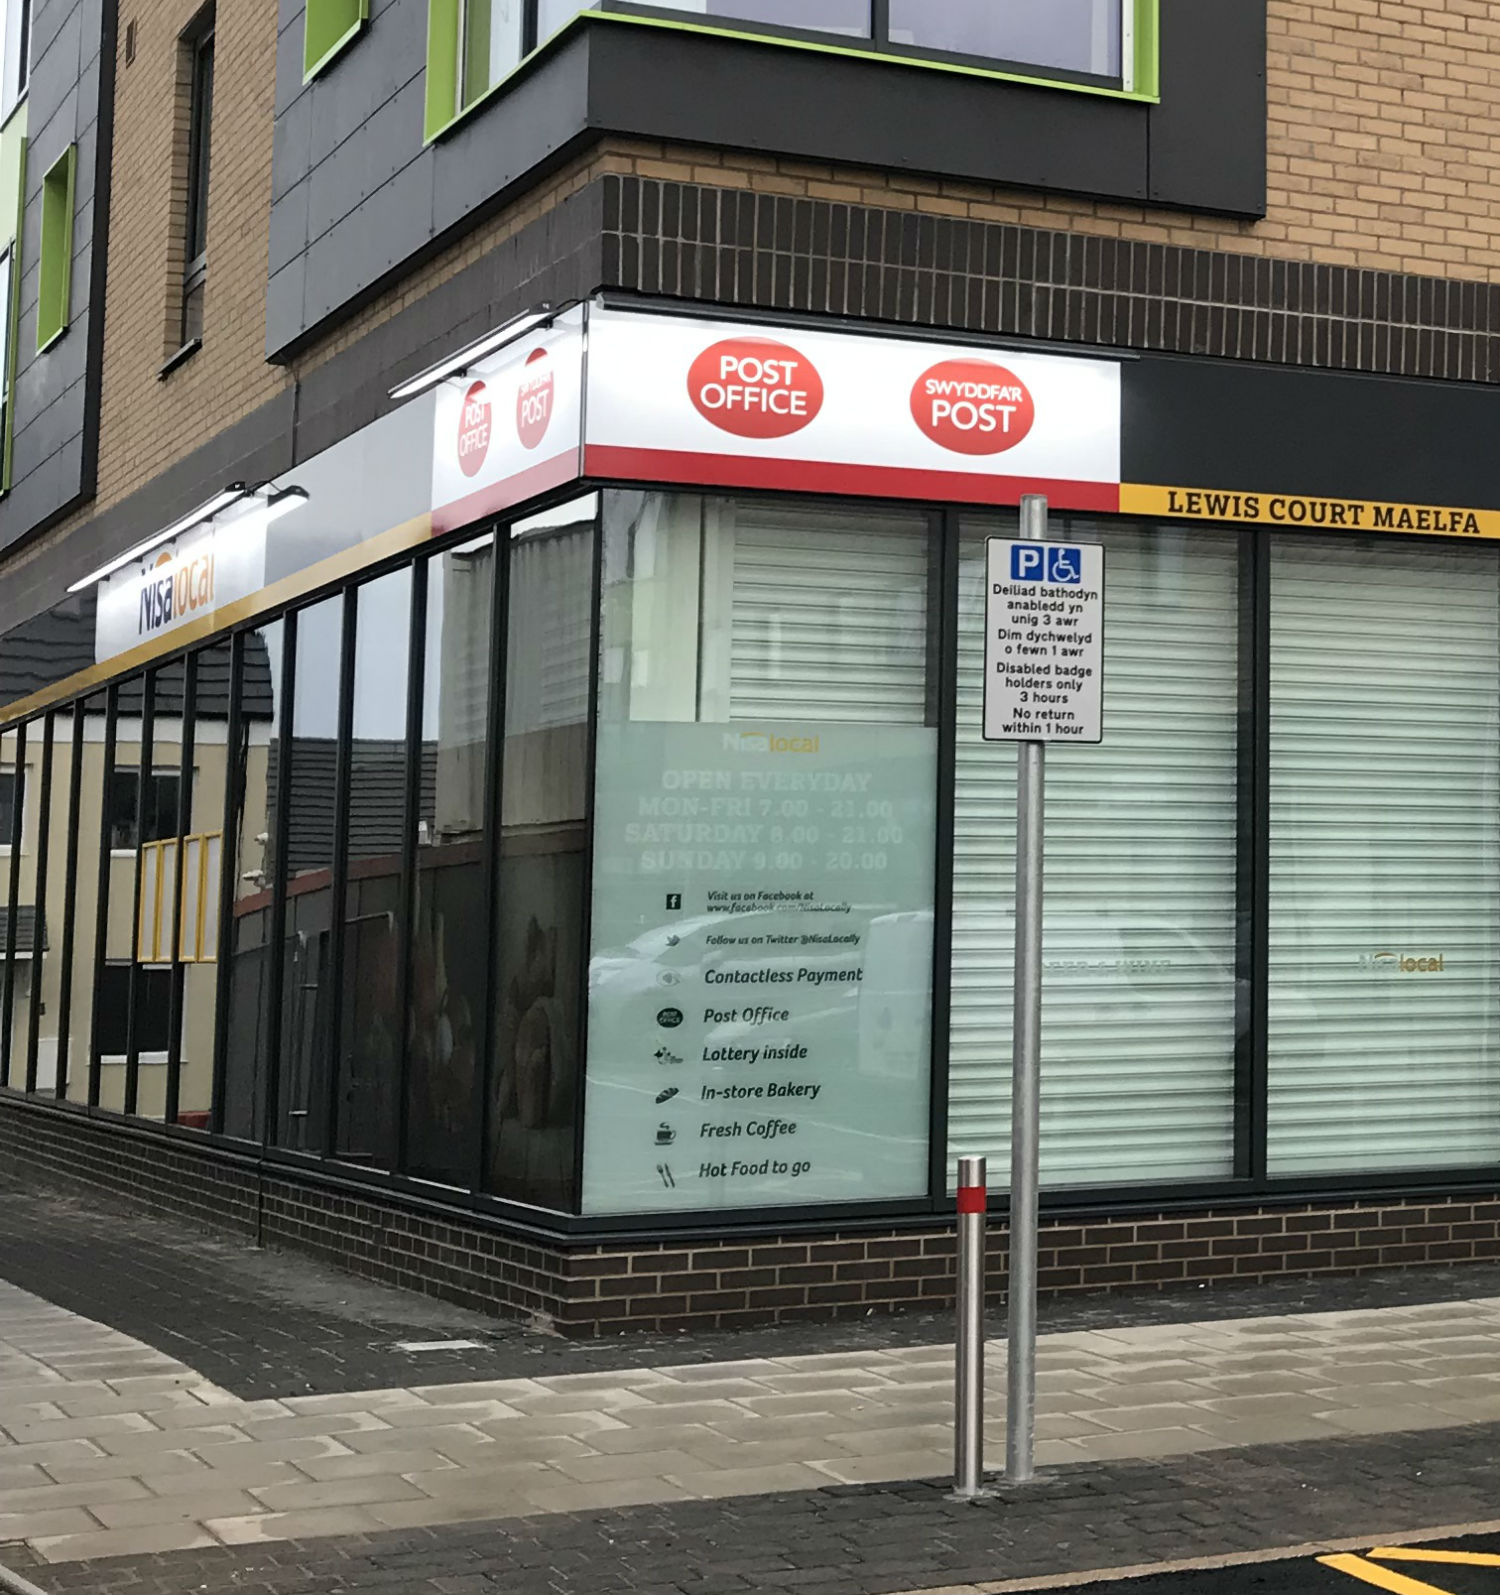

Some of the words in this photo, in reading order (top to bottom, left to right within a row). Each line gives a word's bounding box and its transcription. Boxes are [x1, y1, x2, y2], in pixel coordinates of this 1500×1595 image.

[720, 355, 798, 386] POST
[700, 383, 808, 416] OFFICE
[925, 378, 1023, 403] SWYDDFA'R
[520, 389, 550, 428] POST
[932, 399, 1017, 433] POST
[459, 422, 489, 457] OFFICE
[1167, 490, 1260, 519] LEWIS
[1269, 498, 1365, 526] COURT
[1372, 505, 1481, 534] MAELFA
[1018, 549, 1040, 578] P
[993, 583, 1037, 597] Deiliad
[1040, 586, 1098, 602] bathodyn
[1007, 600, 1065, 612] anabledd
[1068, 604, 1084, 615] yn
[1011, 613, 1039, 627] unig
[1042, 614, 1052, 625] 3
[1055, 617, 1080, 626] awr
[998, 628, 1022, 640] Dim
[1026, 630, 1093, 645] dychwelyd
[1004, 645, 1013, 655] o
[1016, 643, 1048, 656] fewn
[1051, 645, 1057, 656] 1
[1060, 647, 1085, 657] awr
[996, 662, 1051, 675] Disabled
[1055, 664, 1093, 679] badge
[1005, 677, 1053, 689] holders
[1056, 679, 1083, 692] only
[1019, 691, 1029, 702] 3
[1032, 692, 1069, 704] hours
[1012, 707, 1032, 719] No
[1035, 709, 1075, 720] return
[1001, 722, 1042, 733] within
[1045, 723, 1051, 734] 1
[1055, 723, 1085, 735] hour
[661, 770, 732, 792] OPEN
[741, 770, 873, 792] EVERYDAY
[638, 796, 752, 817] MON-FRI
[624, 822, 764, 844] SATURDAY
[640, 849, 747, 871] SUNDAY
[707, 890, 729, 901] Visit
[730, 892, 742, 901] us
[743, 892, 756, 901] on
[757, 890, 802, 901] Facebook
[803, 891, 814, 901] at
[705, 934, 737, 945] Follow
[738, 936, 749, 945] us
[751, 936, 764, 945] on
[765, 934, 799, 944] Twitter
[704, 967, 794, 985] Contactless
[797, 966, 864, 987] Payment
[703, 1007, 738, 1024] Post
[741, 1006, 790, 1025] Office
[702, 1046, 760, 1064] Lottery
[763, 1043, 808, 1060] inside
[700, 1084, 764, 1100] In-store
[766, 1081, 822, 1101] Bakery
[700, 1122, 742, 1138] Fresh
[746, 1120, 797, 1139] Coffee
[698, 1162, 727, 1178] Hot
[731, 1160, 768, 1177] Food
[771, 1160, 788, 1176] to
[791, 1161, 812, 1178] go
